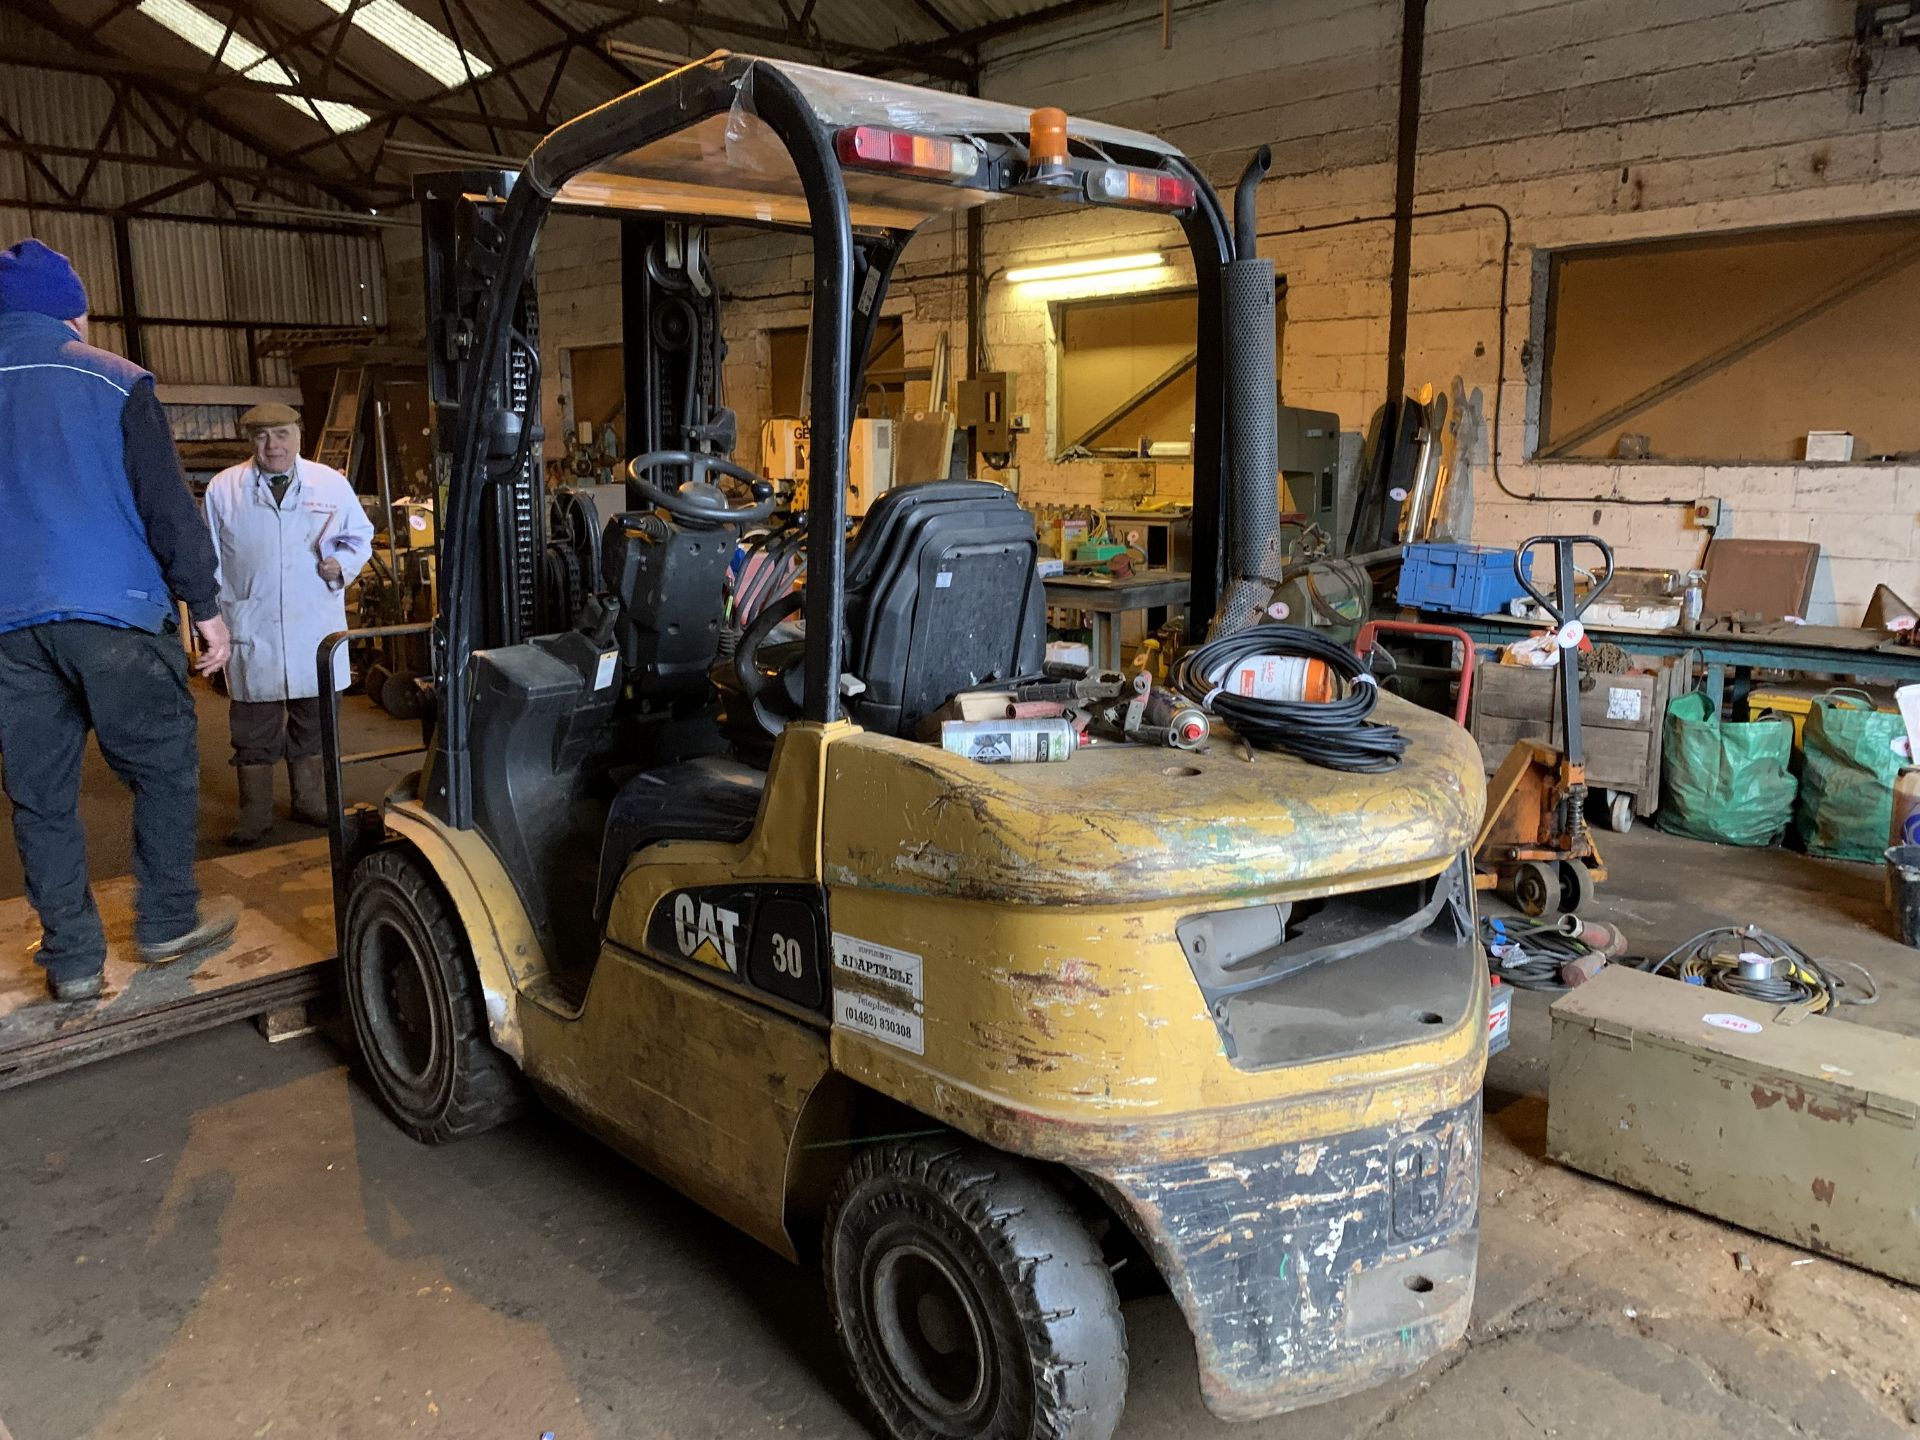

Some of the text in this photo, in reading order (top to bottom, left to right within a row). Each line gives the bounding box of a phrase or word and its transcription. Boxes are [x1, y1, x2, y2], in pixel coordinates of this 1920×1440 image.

[674, 893, 740, 976] CAT
[771, 932, 803, 979] 30
[840, 953, 914, 986] ADAPTABLE
[845, 1006, 913, 1040] (01482) 830308
